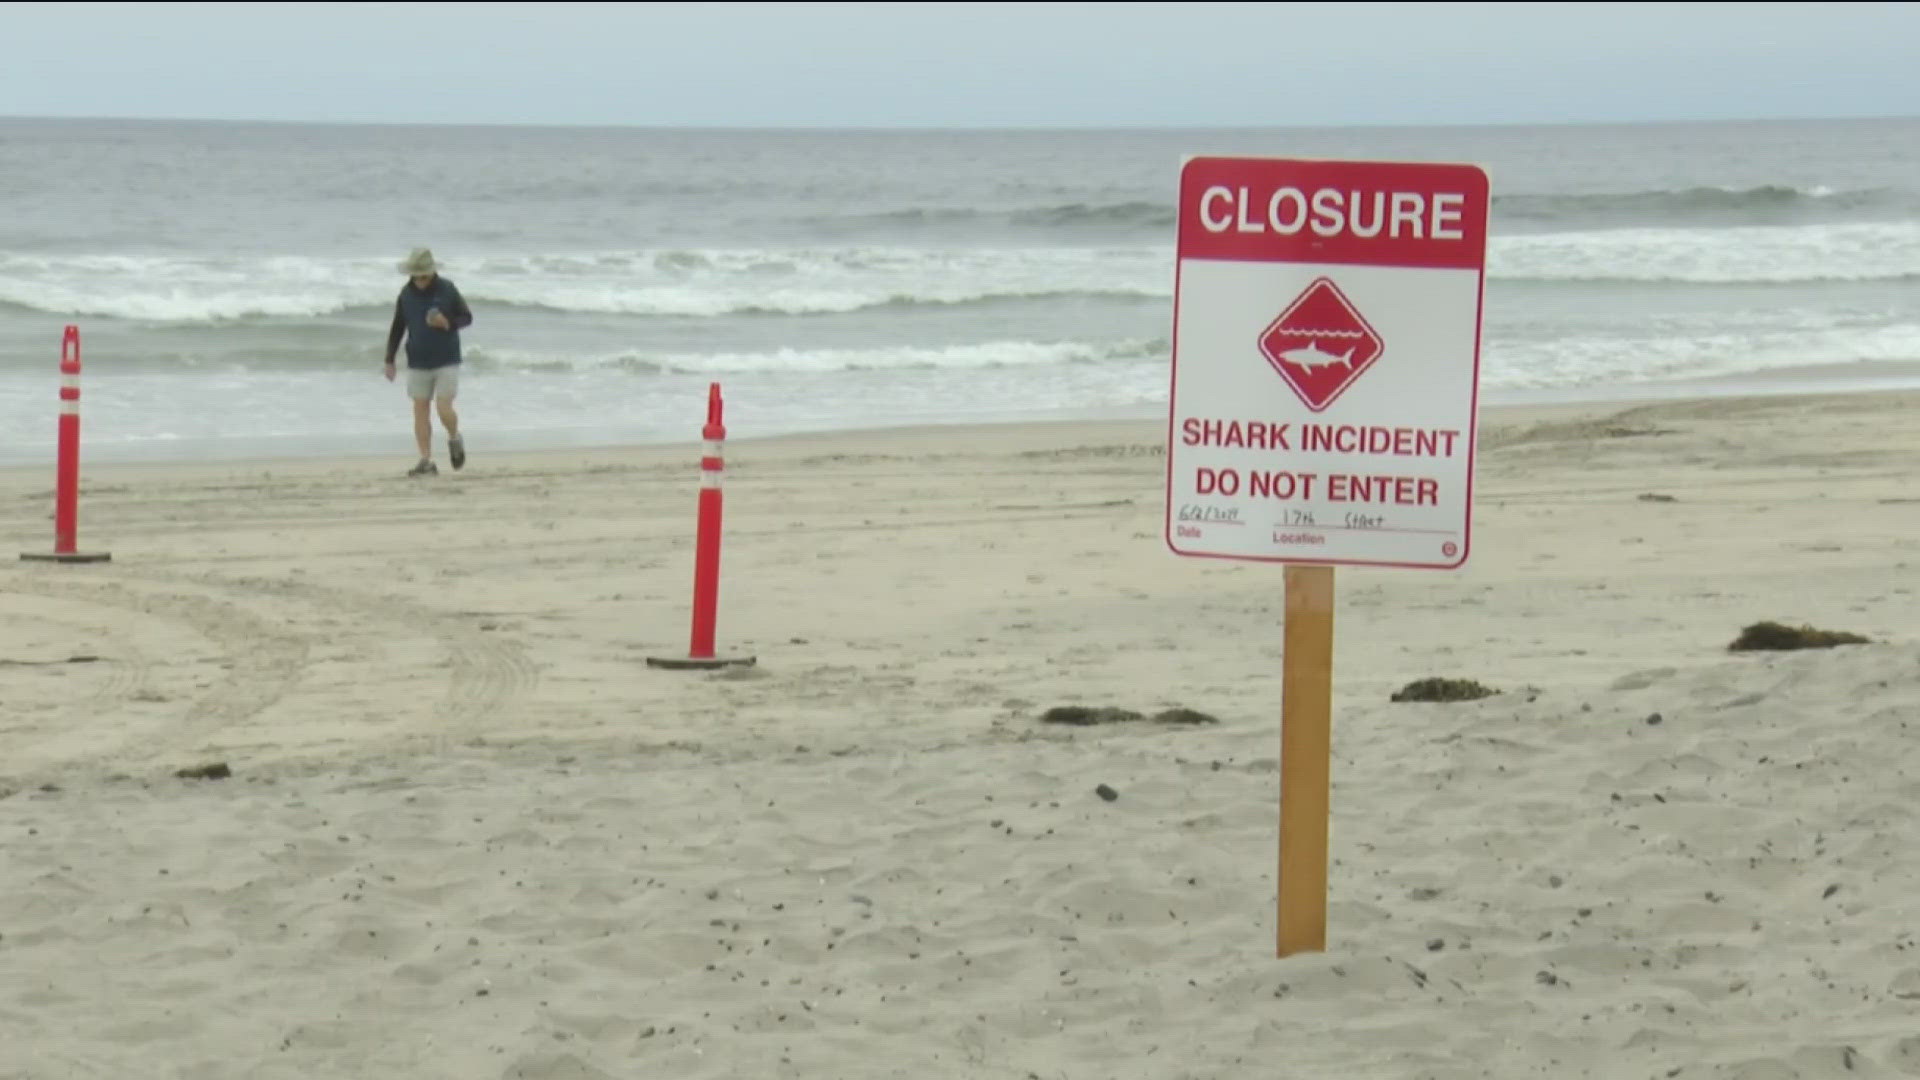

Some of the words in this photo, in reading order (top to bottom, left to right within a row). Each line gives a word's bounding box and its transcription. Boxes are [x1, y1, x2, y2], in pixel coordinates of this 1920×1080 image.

[1199, 185, 1465, 240] CLOSURE
[1182, 417, 1290, 450] SHARK
[1301, 424, 1460, 457] INCIDENT
[1196, 467, 1240, 496] DO
[1250, 470, 1317, 500] NOT
[1327, 474, 1439, 506] ENTER
[1177, 525, 1202, 538] Date
[1283, 509, 1316, 526] 17th
[1272, 531, 1325, 545] Location
